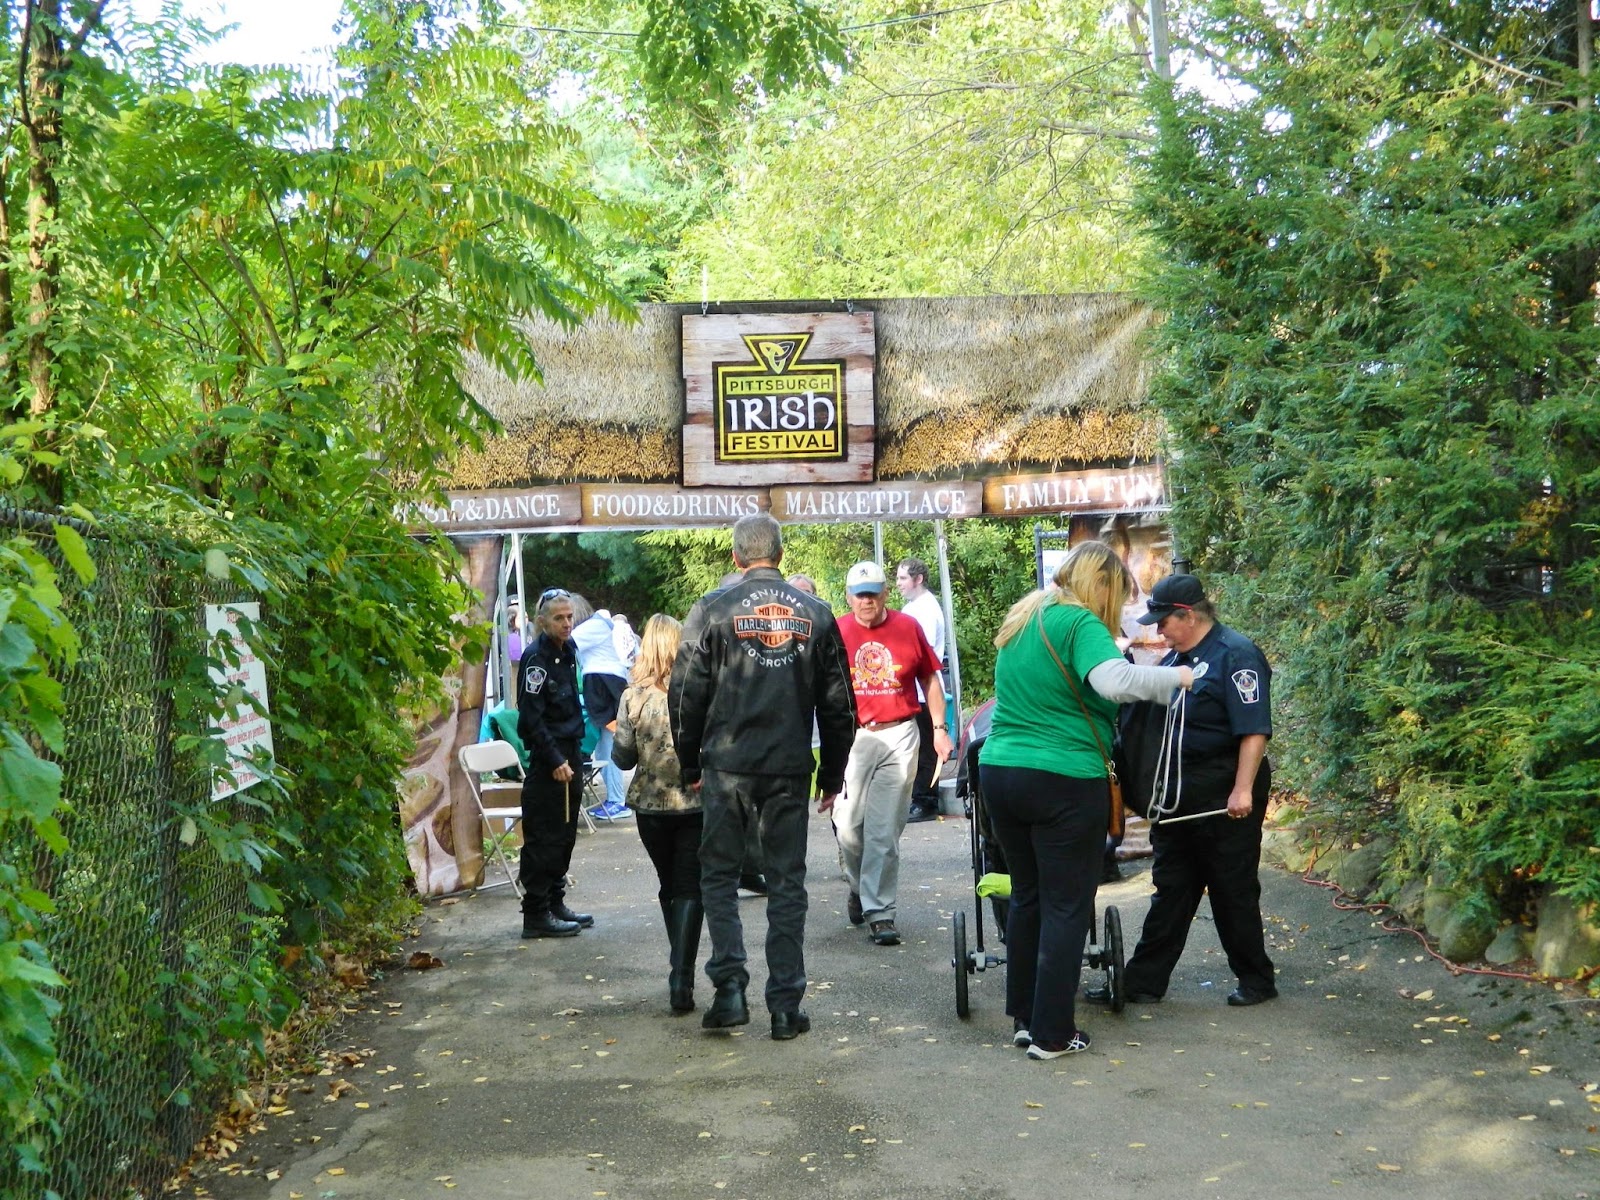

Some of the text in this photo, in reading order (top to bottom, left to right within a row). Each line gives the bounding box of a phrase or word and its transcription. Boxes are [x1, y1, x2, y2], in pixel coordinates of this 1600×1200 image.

[730, 378, 830, 392] PITTSBURGH
[732, 434, 833, 450] FESTIVAL
[1002, 473, 1157, 510] FAMILY FUN
[592, 494, 760, 517] FOOD&DRINKS
[785, 490, 966, 516] MARKETPLACE
[742, 588, 804, 609] GENUINE
[758, 606, 790, 616] MOTOR
[737, 618, 809, 634] HARLEY-DAVIDSON
